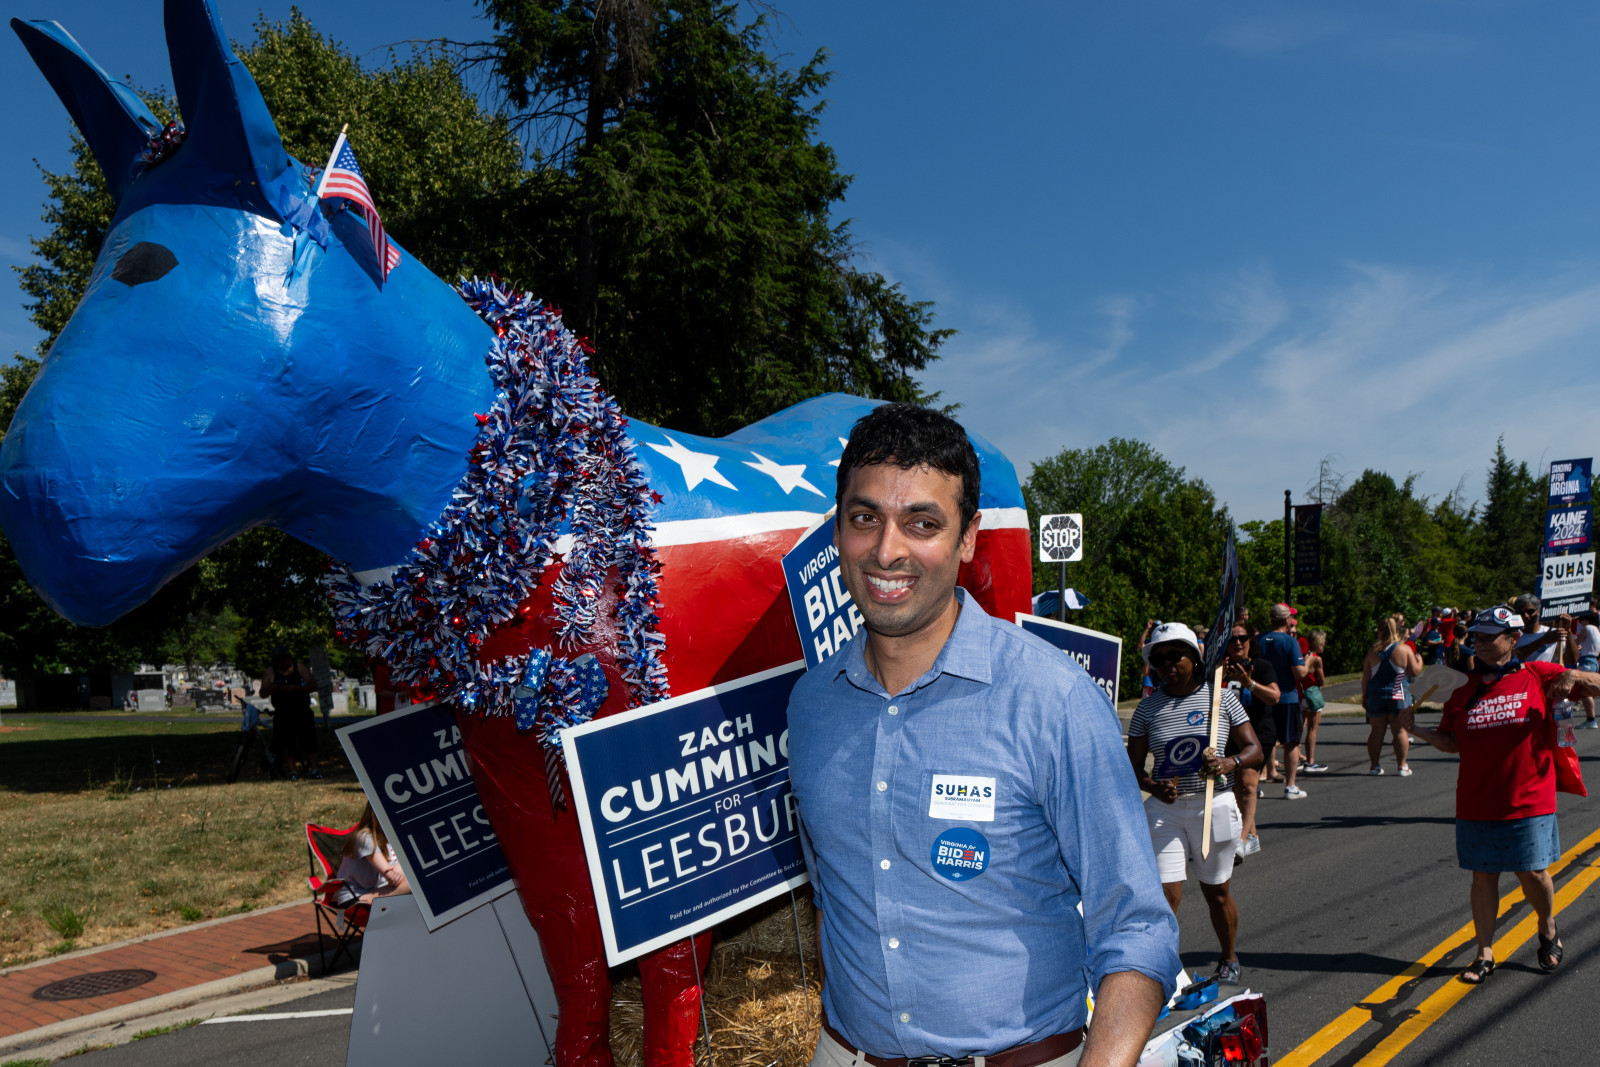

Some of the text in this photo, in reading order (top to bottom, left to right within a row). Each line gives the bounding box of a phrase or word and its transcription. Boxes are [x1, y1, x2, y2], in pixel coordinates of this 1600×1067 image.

[1550, 480, 1580, 496] VIRGINIA
[1550, 510, 1587, 528] KAINE
[1042, 528, 1078, 548] STOP
[1554, 524, 1581, 540] 2024
[799, 544, 840, 586] VIRGIN
[1546, 560, 1593, 580] SUHAS
[1468, 701, 1522, 715] DEMAND
[1467, 710, 1516, 724] ACTION
[678, 713, 754, 757] ZACH
[936, 784, 992, 798] SUHAS
[715, 794, 742, 814] FOR
[940, 840, 967, 849] VIRGINIA
[938, 846, 984, 861] BIDEN
[936, 856, 983, 870] HARRIS
[670, 911, 682, 920] Paid
[684, 906, 692, 915] for
[692, 902, 703, 912] and
[704, 890, 732, 907] authorized
[740, 882, 749, 891] the
[750, 872, 777, 886] Committee
